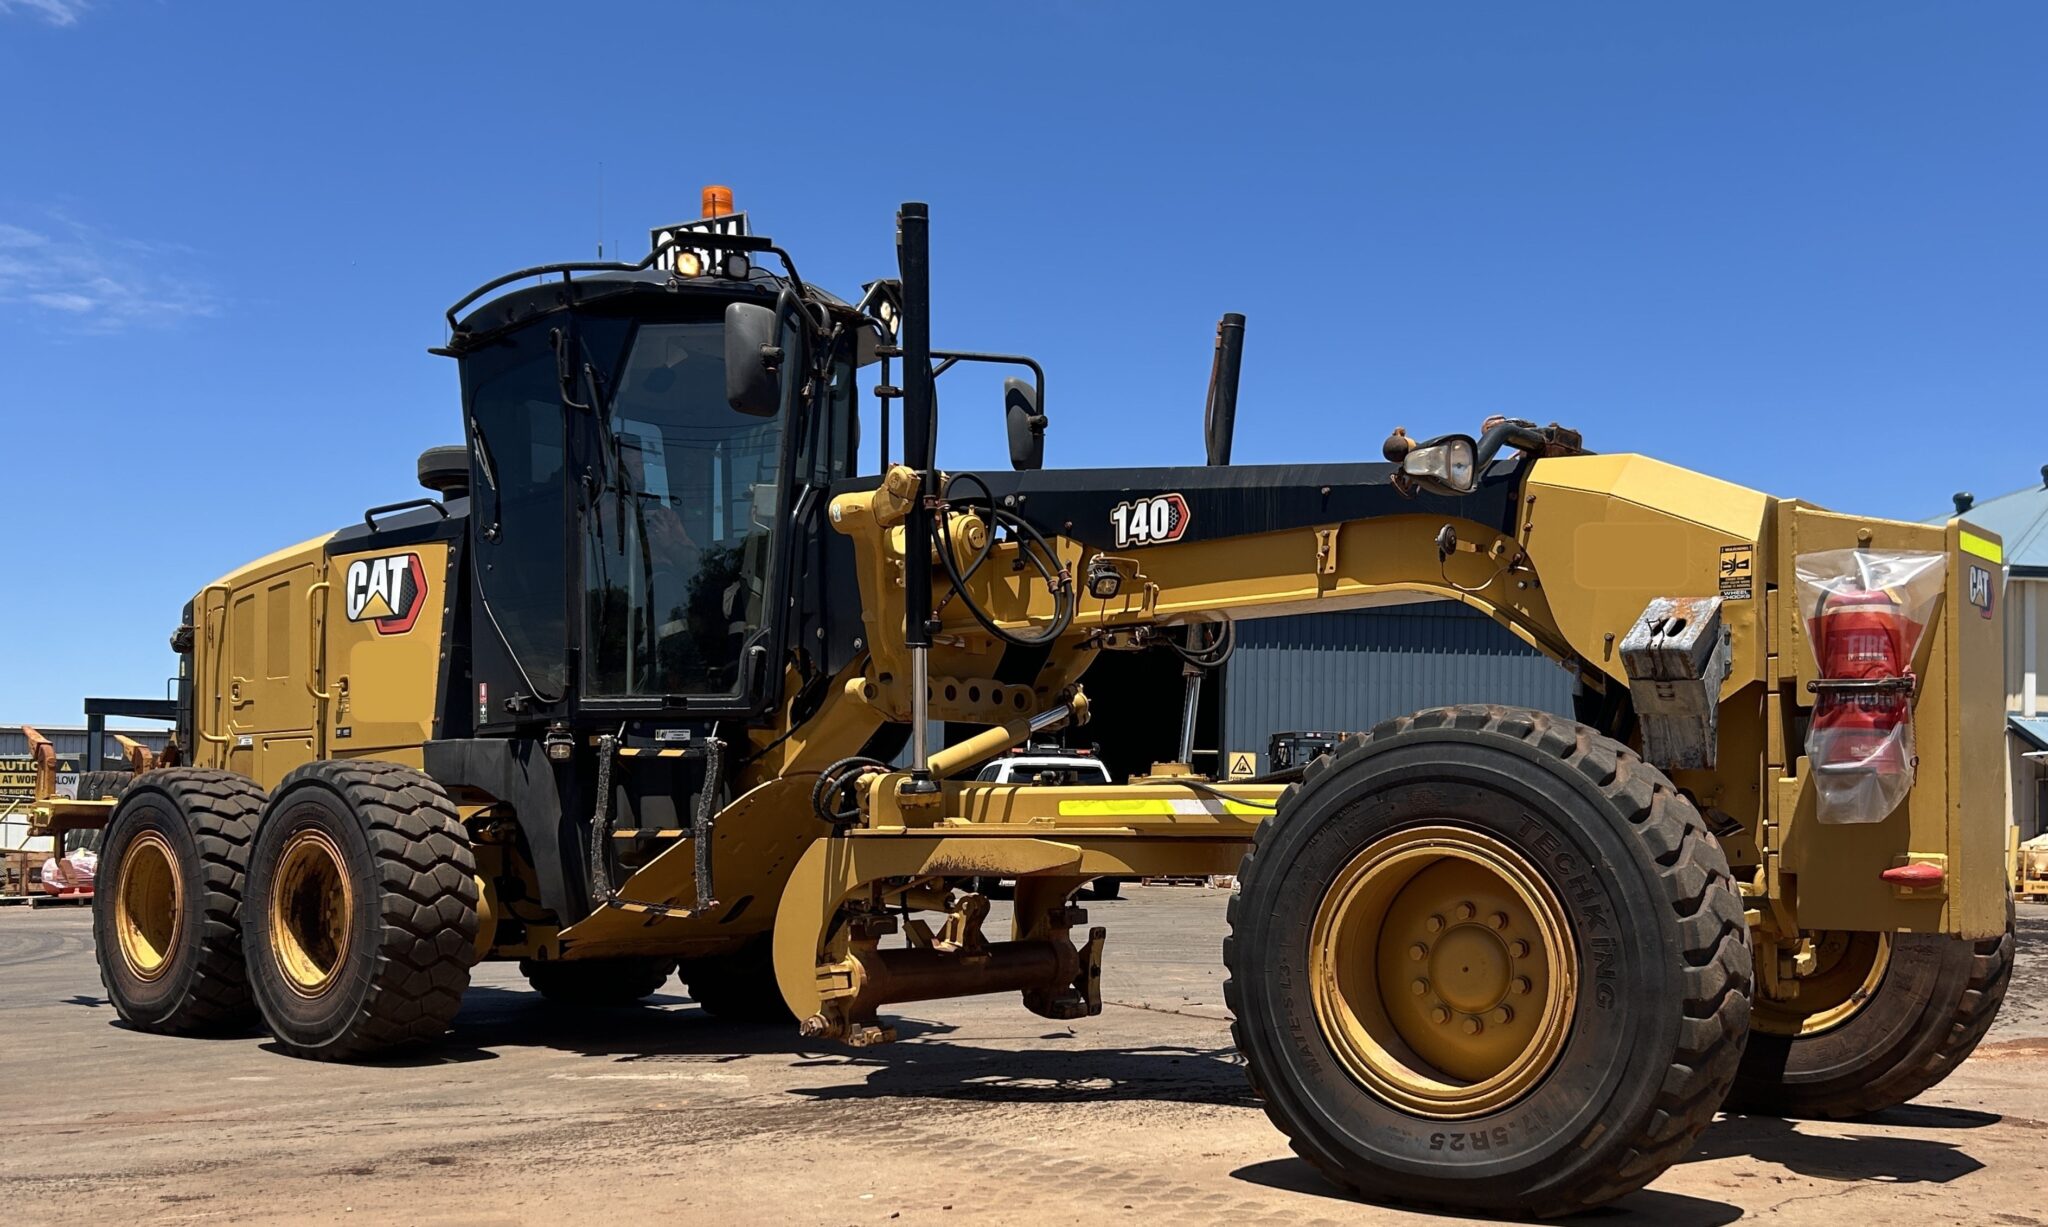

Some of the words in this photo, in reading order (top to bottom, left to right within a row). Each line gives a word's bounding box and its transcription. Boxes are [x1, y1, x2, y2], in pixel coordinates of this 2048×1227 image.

[1113, 499, 1169, 543] 140
[347, 555, 409, 620] CAT
[1970, 566, 1989, 607] CAT
[16, 774, 37, 784] WOR
